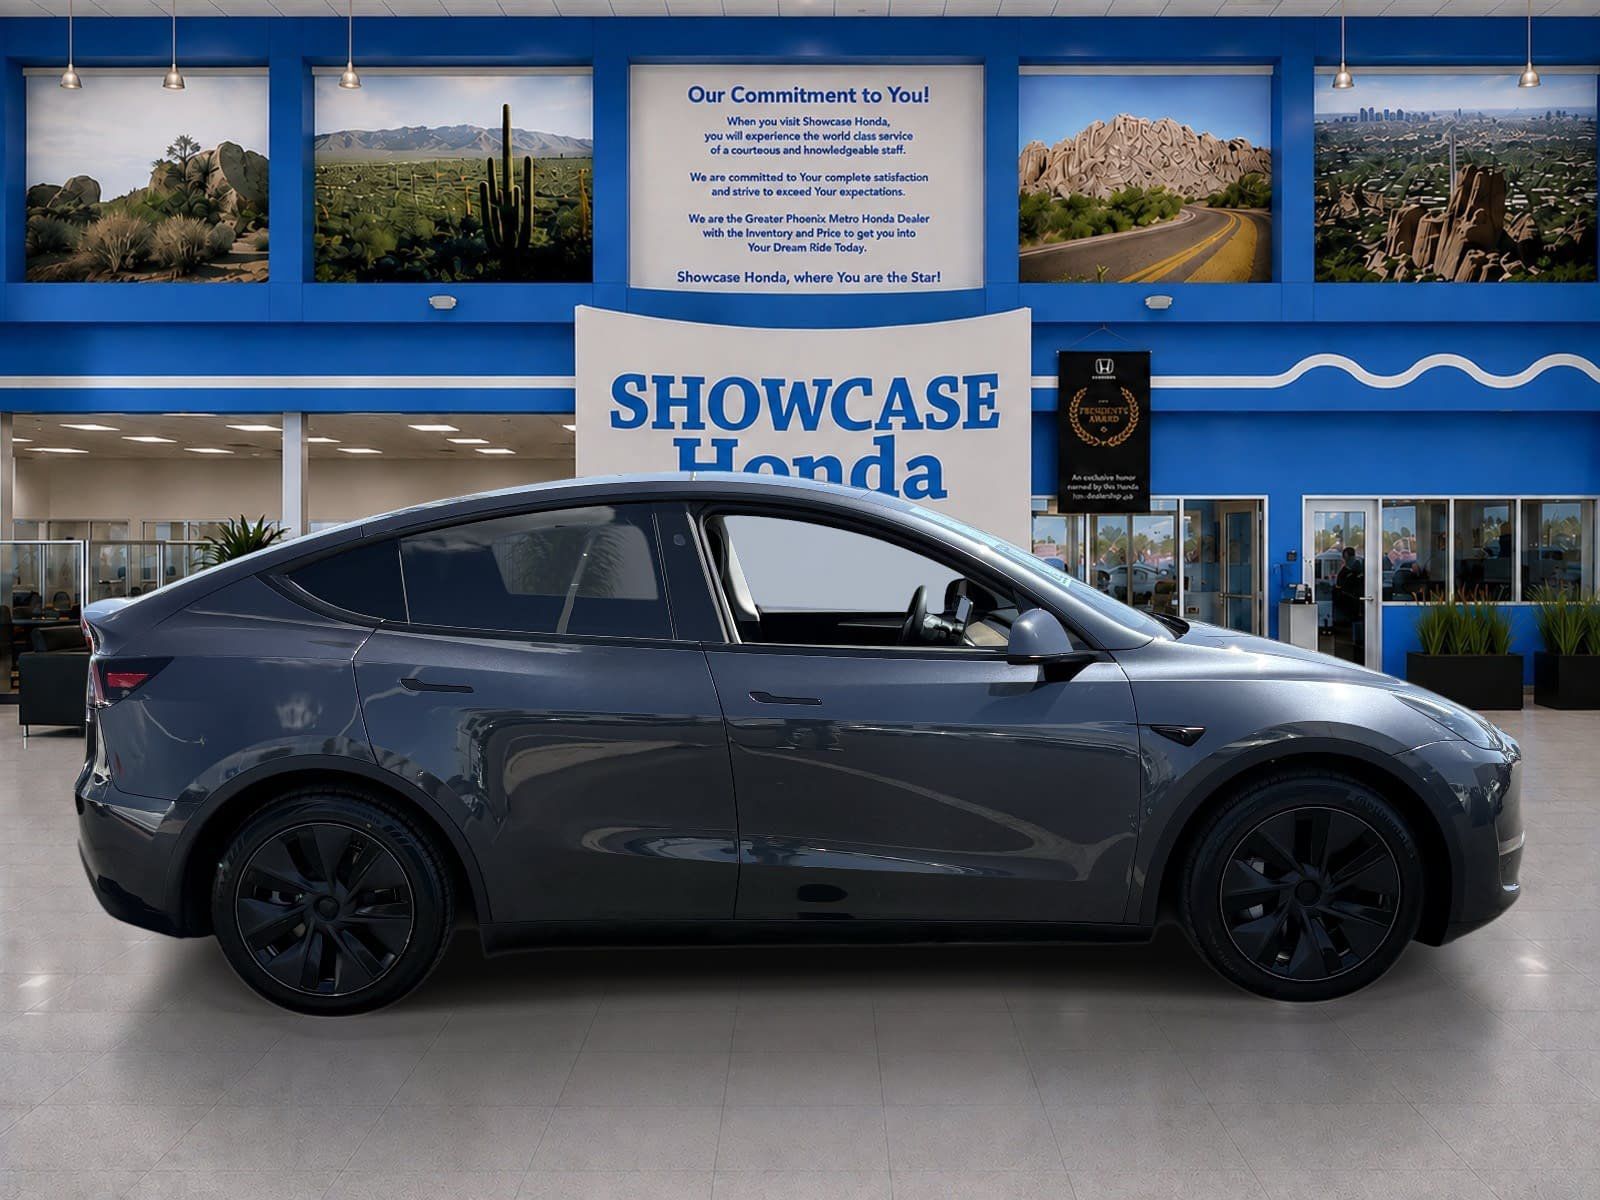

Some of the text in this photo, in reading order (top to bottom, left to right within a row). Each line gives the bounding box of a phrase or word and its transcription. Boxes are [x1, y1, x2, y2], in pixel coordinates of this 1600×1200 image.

[687, 85, 929, 104] Our Commitment to You!
[726, 115, 891, 129] When you visit Showcase Honda,
[704, 130, 914, 144] you will experience the world class service
[710, 144, 721, 155] of
[722, 147, 730, 155] a
[730, 146, 781, 156] courteous
[782, 144, 802, 155] and
[881, 144, 906, 155] staff.
[689, 171, 929, 185] We are committed to Your complete satisfaction
[711, 185, 906, 200] and strive to exceed Your expectations.
[688, 213, 931, 224] We are the Greater Phoenix Metro Honda Dealer
[702, 227, 917, 241] with the Inventory and Price to get you into
[747, 242, 868, 255] Your Dream Ride Today.
[677, 270, 941, 286] Showcase Honda, where You are the Star!
[609, 372, 1001, 432] SHOWCASE
